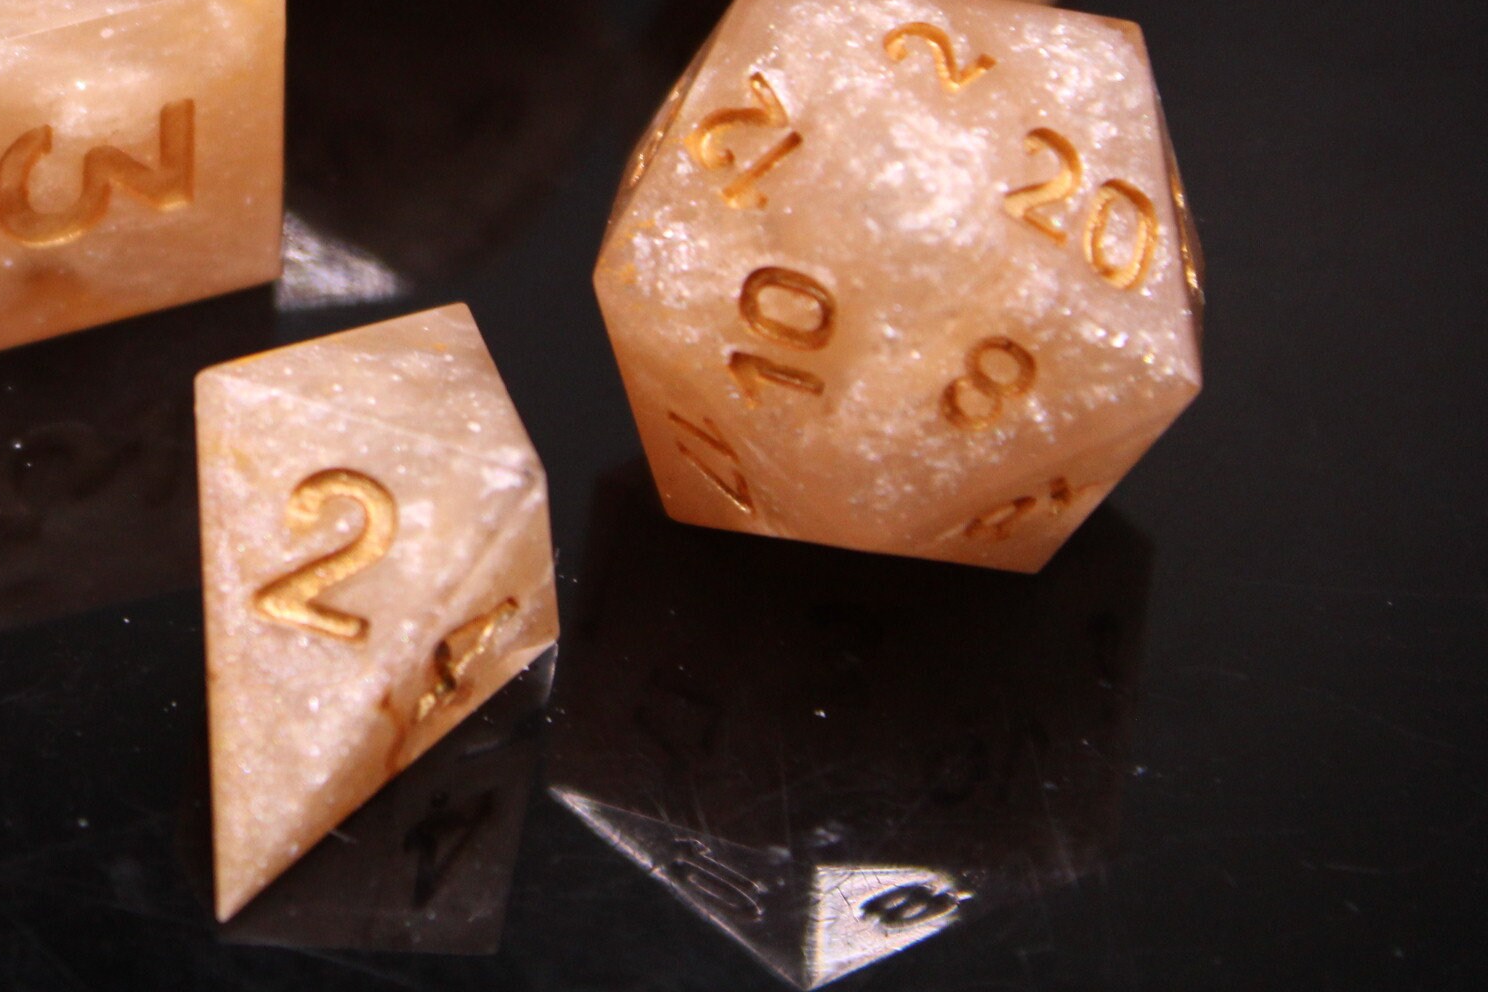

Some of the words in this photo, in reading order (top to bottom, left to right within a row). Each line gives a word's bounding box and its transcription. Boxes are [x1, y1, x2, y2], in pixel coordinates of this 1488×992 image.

[883, 20, 997, 91] 2
[689, 71, 803, 210] 12
[1003, 126, 1162, 291] 20
[727, 265, 838, 407] 10
[943, 336, 1036, 430] 8
[253, 467, 399, 644] 2
